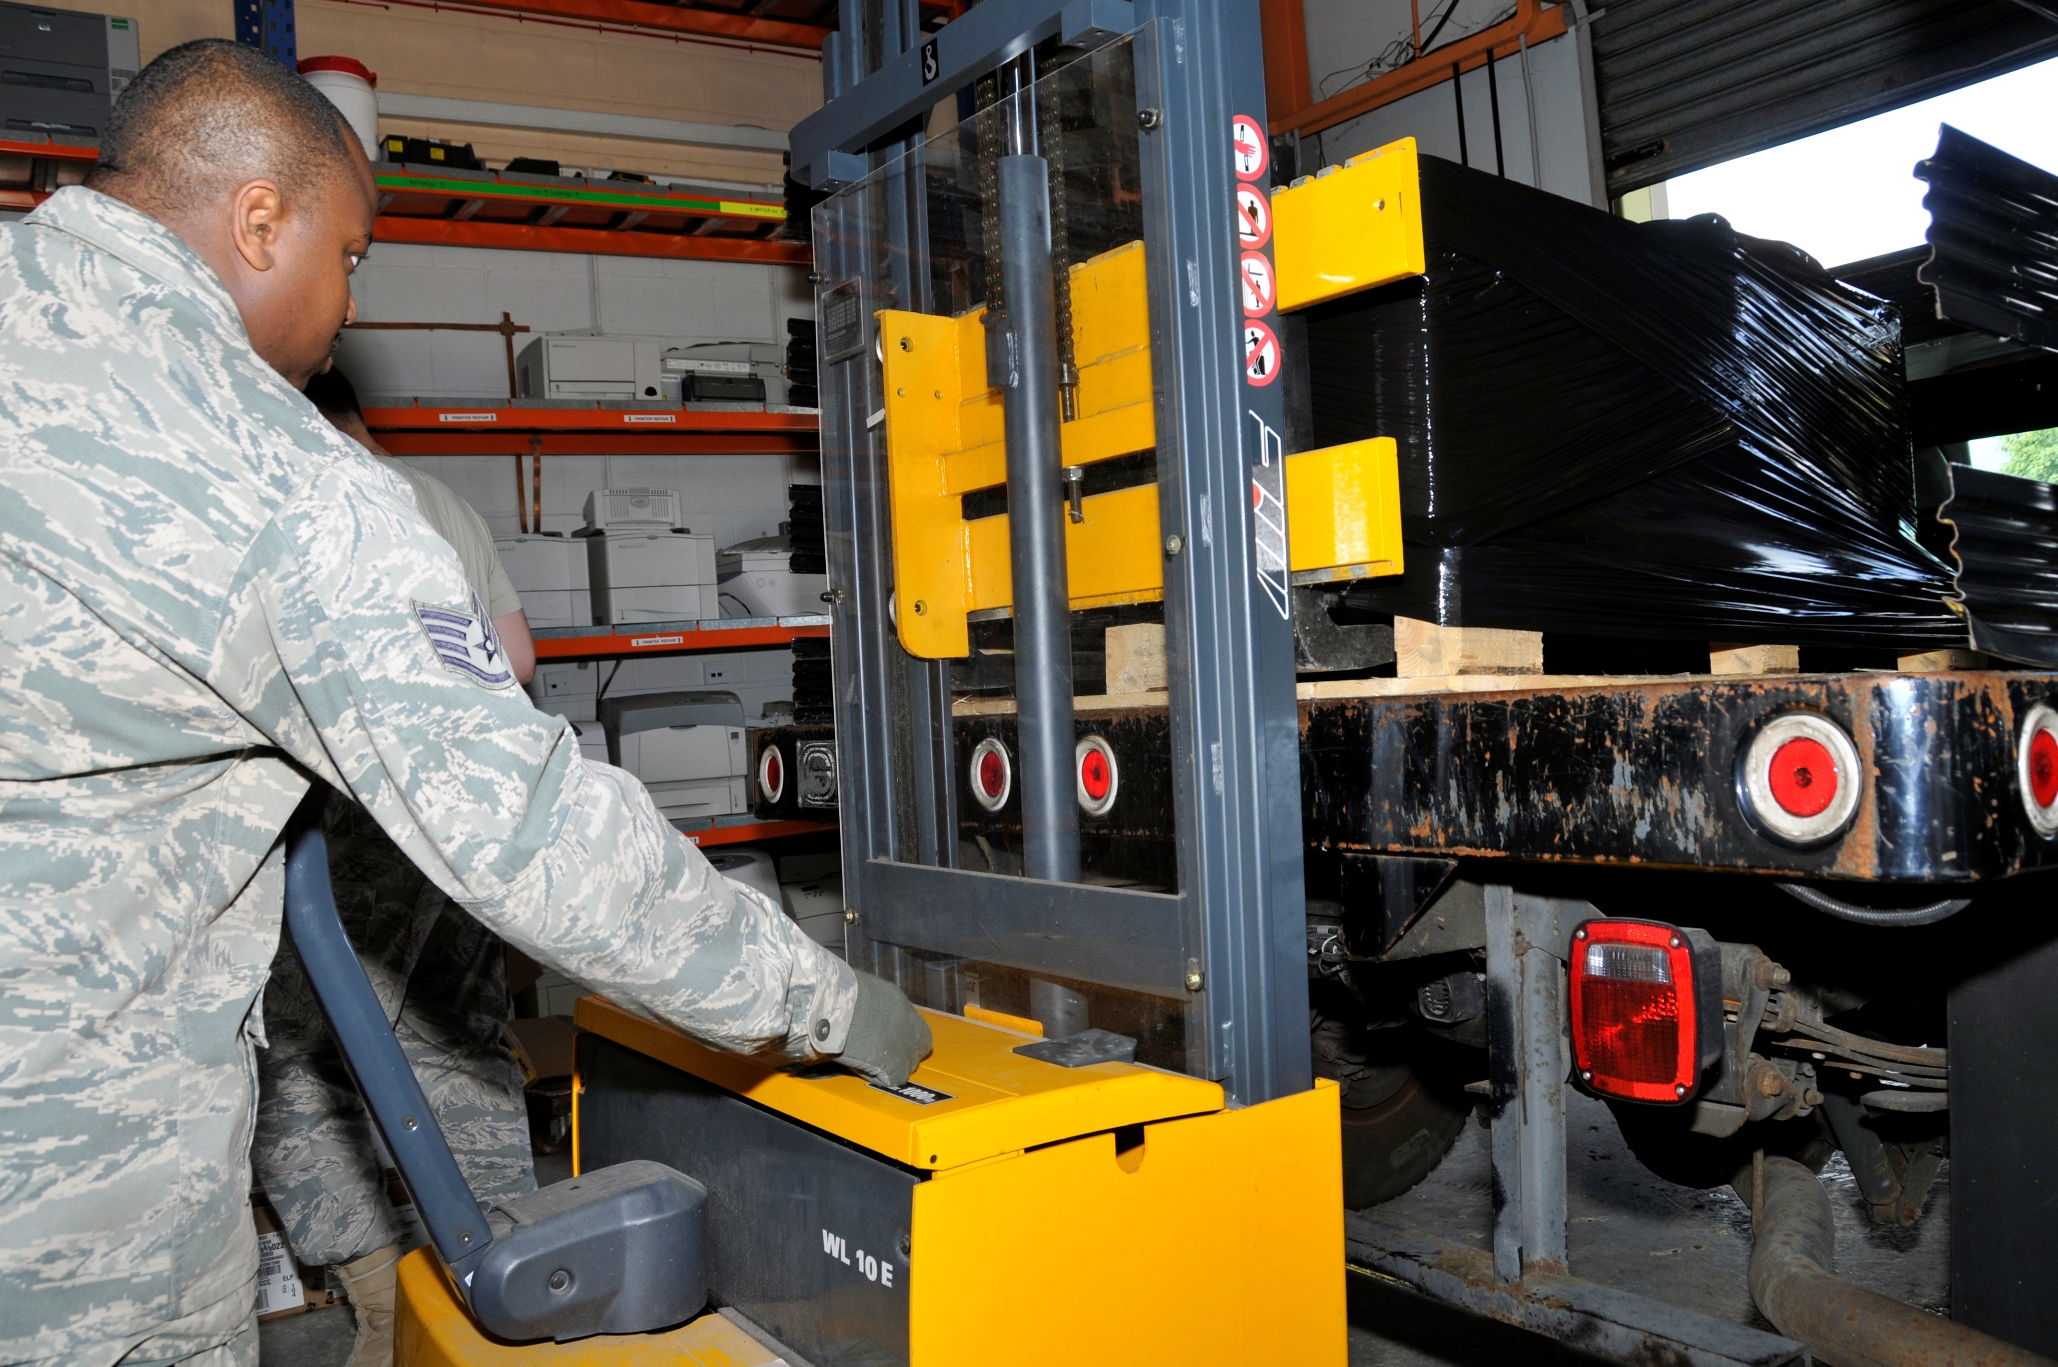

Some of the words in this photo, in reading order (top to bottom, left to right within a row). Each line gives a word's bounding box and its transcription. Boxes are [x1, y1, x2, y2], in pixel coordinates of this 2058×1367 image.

[822, 1228, 851, 1266] WL
[856, 1249, 878, 1282] 10
[881, 1260, 894, 1289] E
